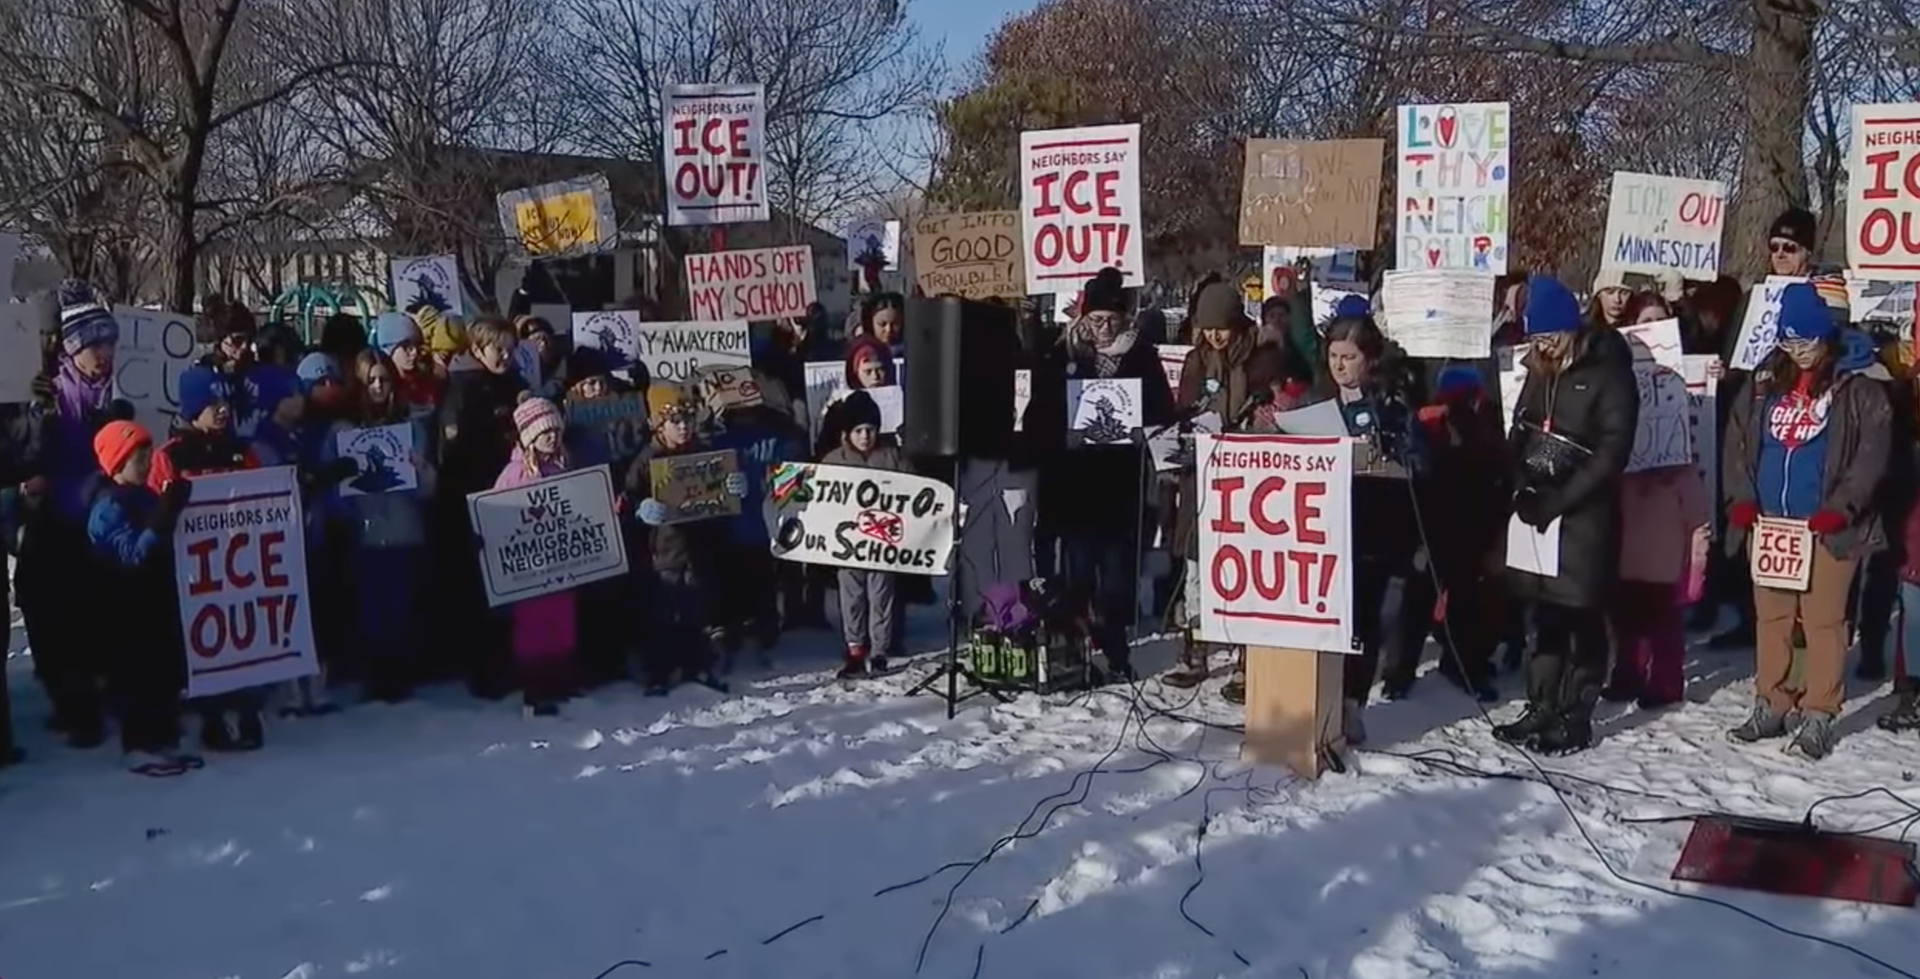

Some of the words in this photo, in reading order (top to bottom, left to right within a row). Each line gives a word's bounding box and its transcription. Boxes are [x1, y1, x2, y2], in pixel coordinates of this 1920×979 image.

[672, 103, 732, 116] NEIGHBORS
[735, 103, 754, 114] SAY
[1407, 105, 1507, 148] LOVE
[674, 118, 751, 157] ICE
[1032, 152, 1100, 170] NEIGHBORS
[1104, 151, 1127, 164] SAY
[675, 162, 759, 200] OUT!
[1033, 170, 1122, 218] ICE
[916, 216, 950, 235] GET
[961, 213, 1015, 230] INTO
[1679, 193, 1722, 226] OUT
[931, 234, 1014, 263] GOOD
[1034, 223, 1130, 267] OUT!
[1614, 231, 1716, 272] MINNESOTA
[688, 253, 767, 284] HANDS
[772, 250, 806, 275] OFF
[693, 287, 724, 322] MY
[663, 330, 709, 353] AWAY
[710, 330, 746, 350] FROM
[657, 358, 700, 380] OUR
[1210, 452, 1301, 472] NEIGHBORS
[1306, 456, 1336, 472] SAY
[528, 486, 560, 506] WE
[794, 480, 854, 506] STAY
[856, 479, 910, 514] OUT
[912, 487, 944, 518] OF
[1211, 476, 1326, 544] ICE
[184, 510, 263, 534] NEIGHBORS
[266, 506, 290, 524] SAY
[533, 518, 567, 536] OUR
[500, 523, 606, 561] IMMIGRANT
[502, 537, 608, 576] NEIGHBORS!
[773, 518, 826, 555] OUR
[832, 521, 936, 568] SCHOOLS
[1760, 533, 1801, 556] ICE
[187, 531, 289, 596] ICE
[1211, 544, 1338, 613] OUT!
[1758, 554, 1804, 577] OUT!
[190, 594, 298, 658] OUT!
